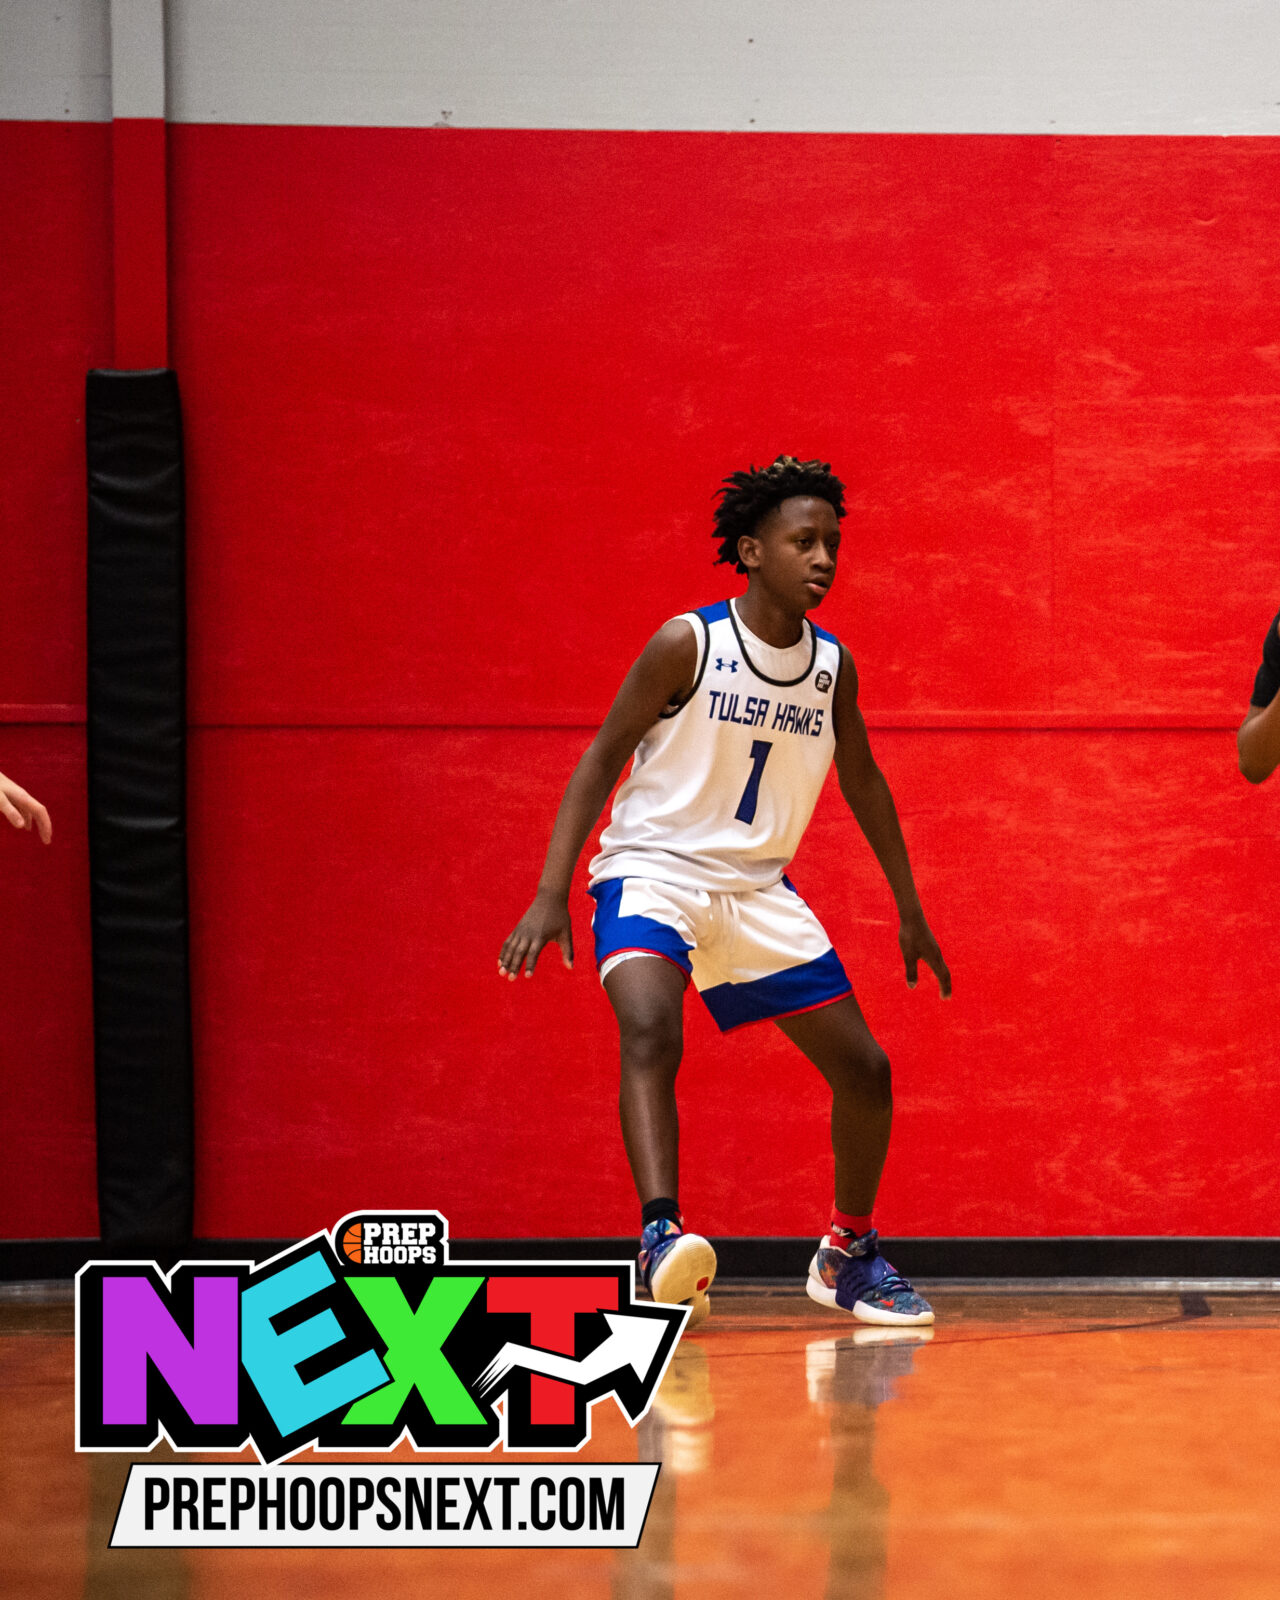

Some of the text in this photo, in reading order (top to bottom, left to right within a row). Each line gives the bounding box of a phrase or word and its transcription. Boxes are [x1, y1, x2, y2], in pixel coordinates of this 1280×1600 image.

[709, 690, 824, 737] TULSA HAWKS
[734, 739, 773, 825] 1
